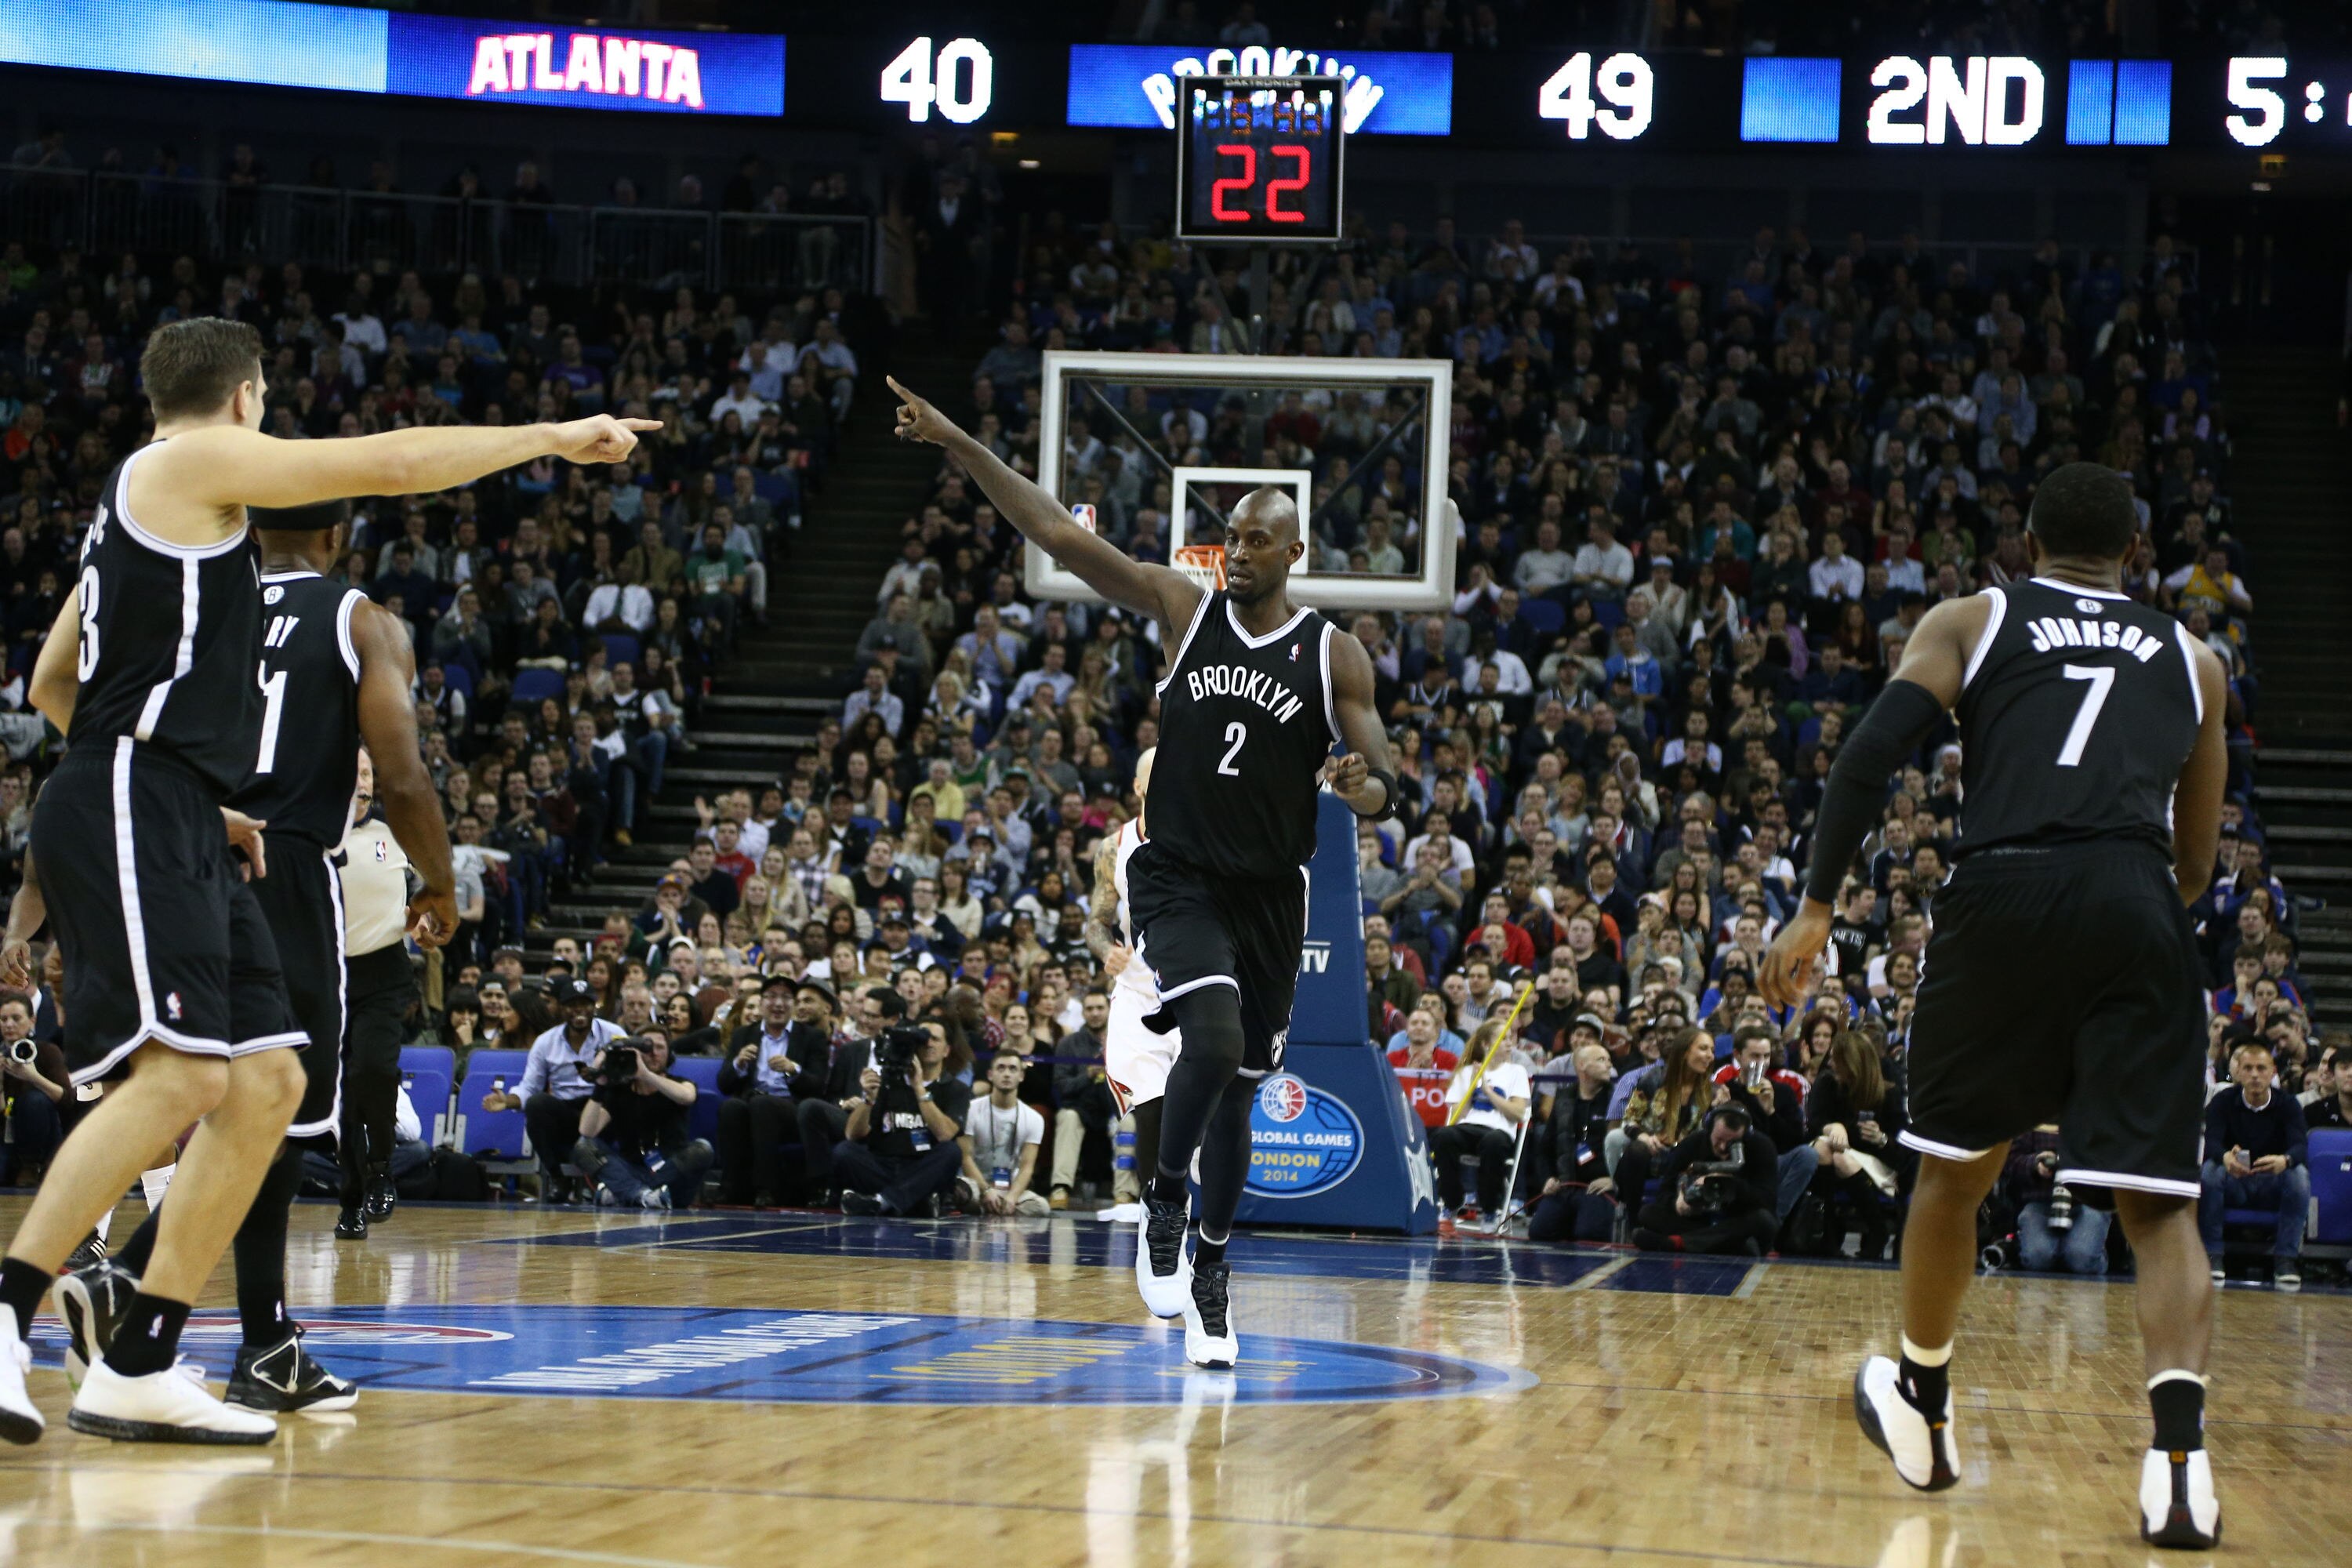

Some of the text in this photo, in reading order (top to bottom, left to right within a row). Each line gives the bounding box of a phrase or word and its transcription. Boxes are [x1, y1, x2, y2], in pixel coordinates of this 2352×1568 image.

[467, 33, 705, 110] ATLANTA
[881, 36, 993, 124] 40
[1539, 52, 1654, 140] 49
[1868, 56, 2045, 145] 2ND
[2226, 57, 2352, 147] 5:
[1211, 145, 1311, 222] 22
[264, 615, 300, 648] RY
[2026, 617, 2164, 663] JOHNSON
[1187, 665, 1304, 724] BROOKLYN
[2056, 663, 2116, 767] 7
[1217, 721, 1247, 776] 2
[1301, 949, 1330, 973] TV
[895, 1112, 924, 1129] NBA
[1412, 1087, 1447, 1108] PO
[1250, 1151, 1320, 1167] ONDON
[1303, 1133, 1352, 1147] GAMES
[1263, 1170, 1298, 1181] 2014
